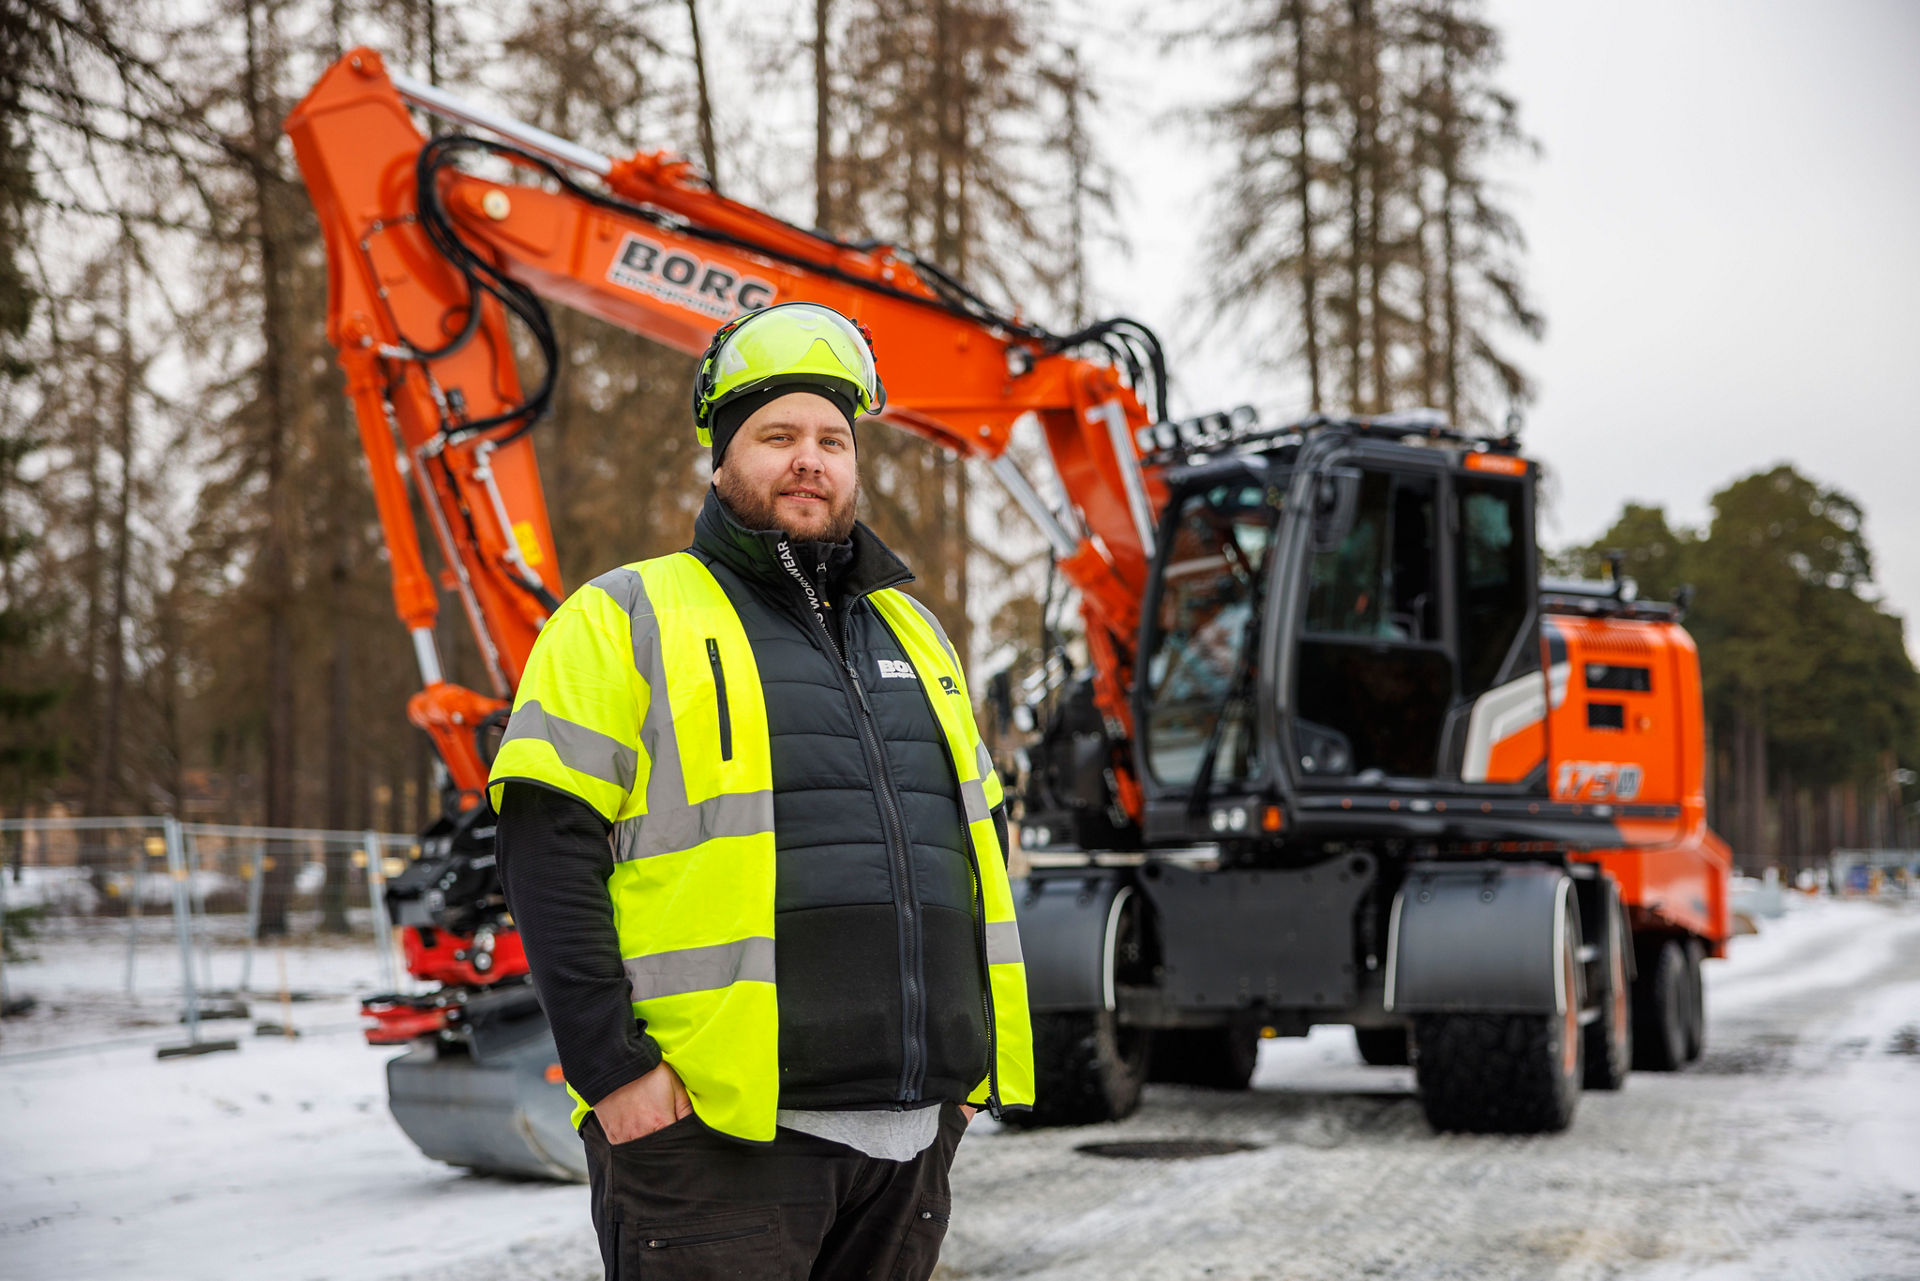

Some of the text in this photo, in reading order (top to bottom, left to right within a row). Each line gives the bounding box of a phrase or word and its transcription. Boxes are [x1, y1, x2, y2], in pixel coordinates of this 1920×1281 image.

[620, 240, 771, 310] BORG
[777, 540, 820, 610] WORKWEAR
[877, 660, 914, 673] BO
